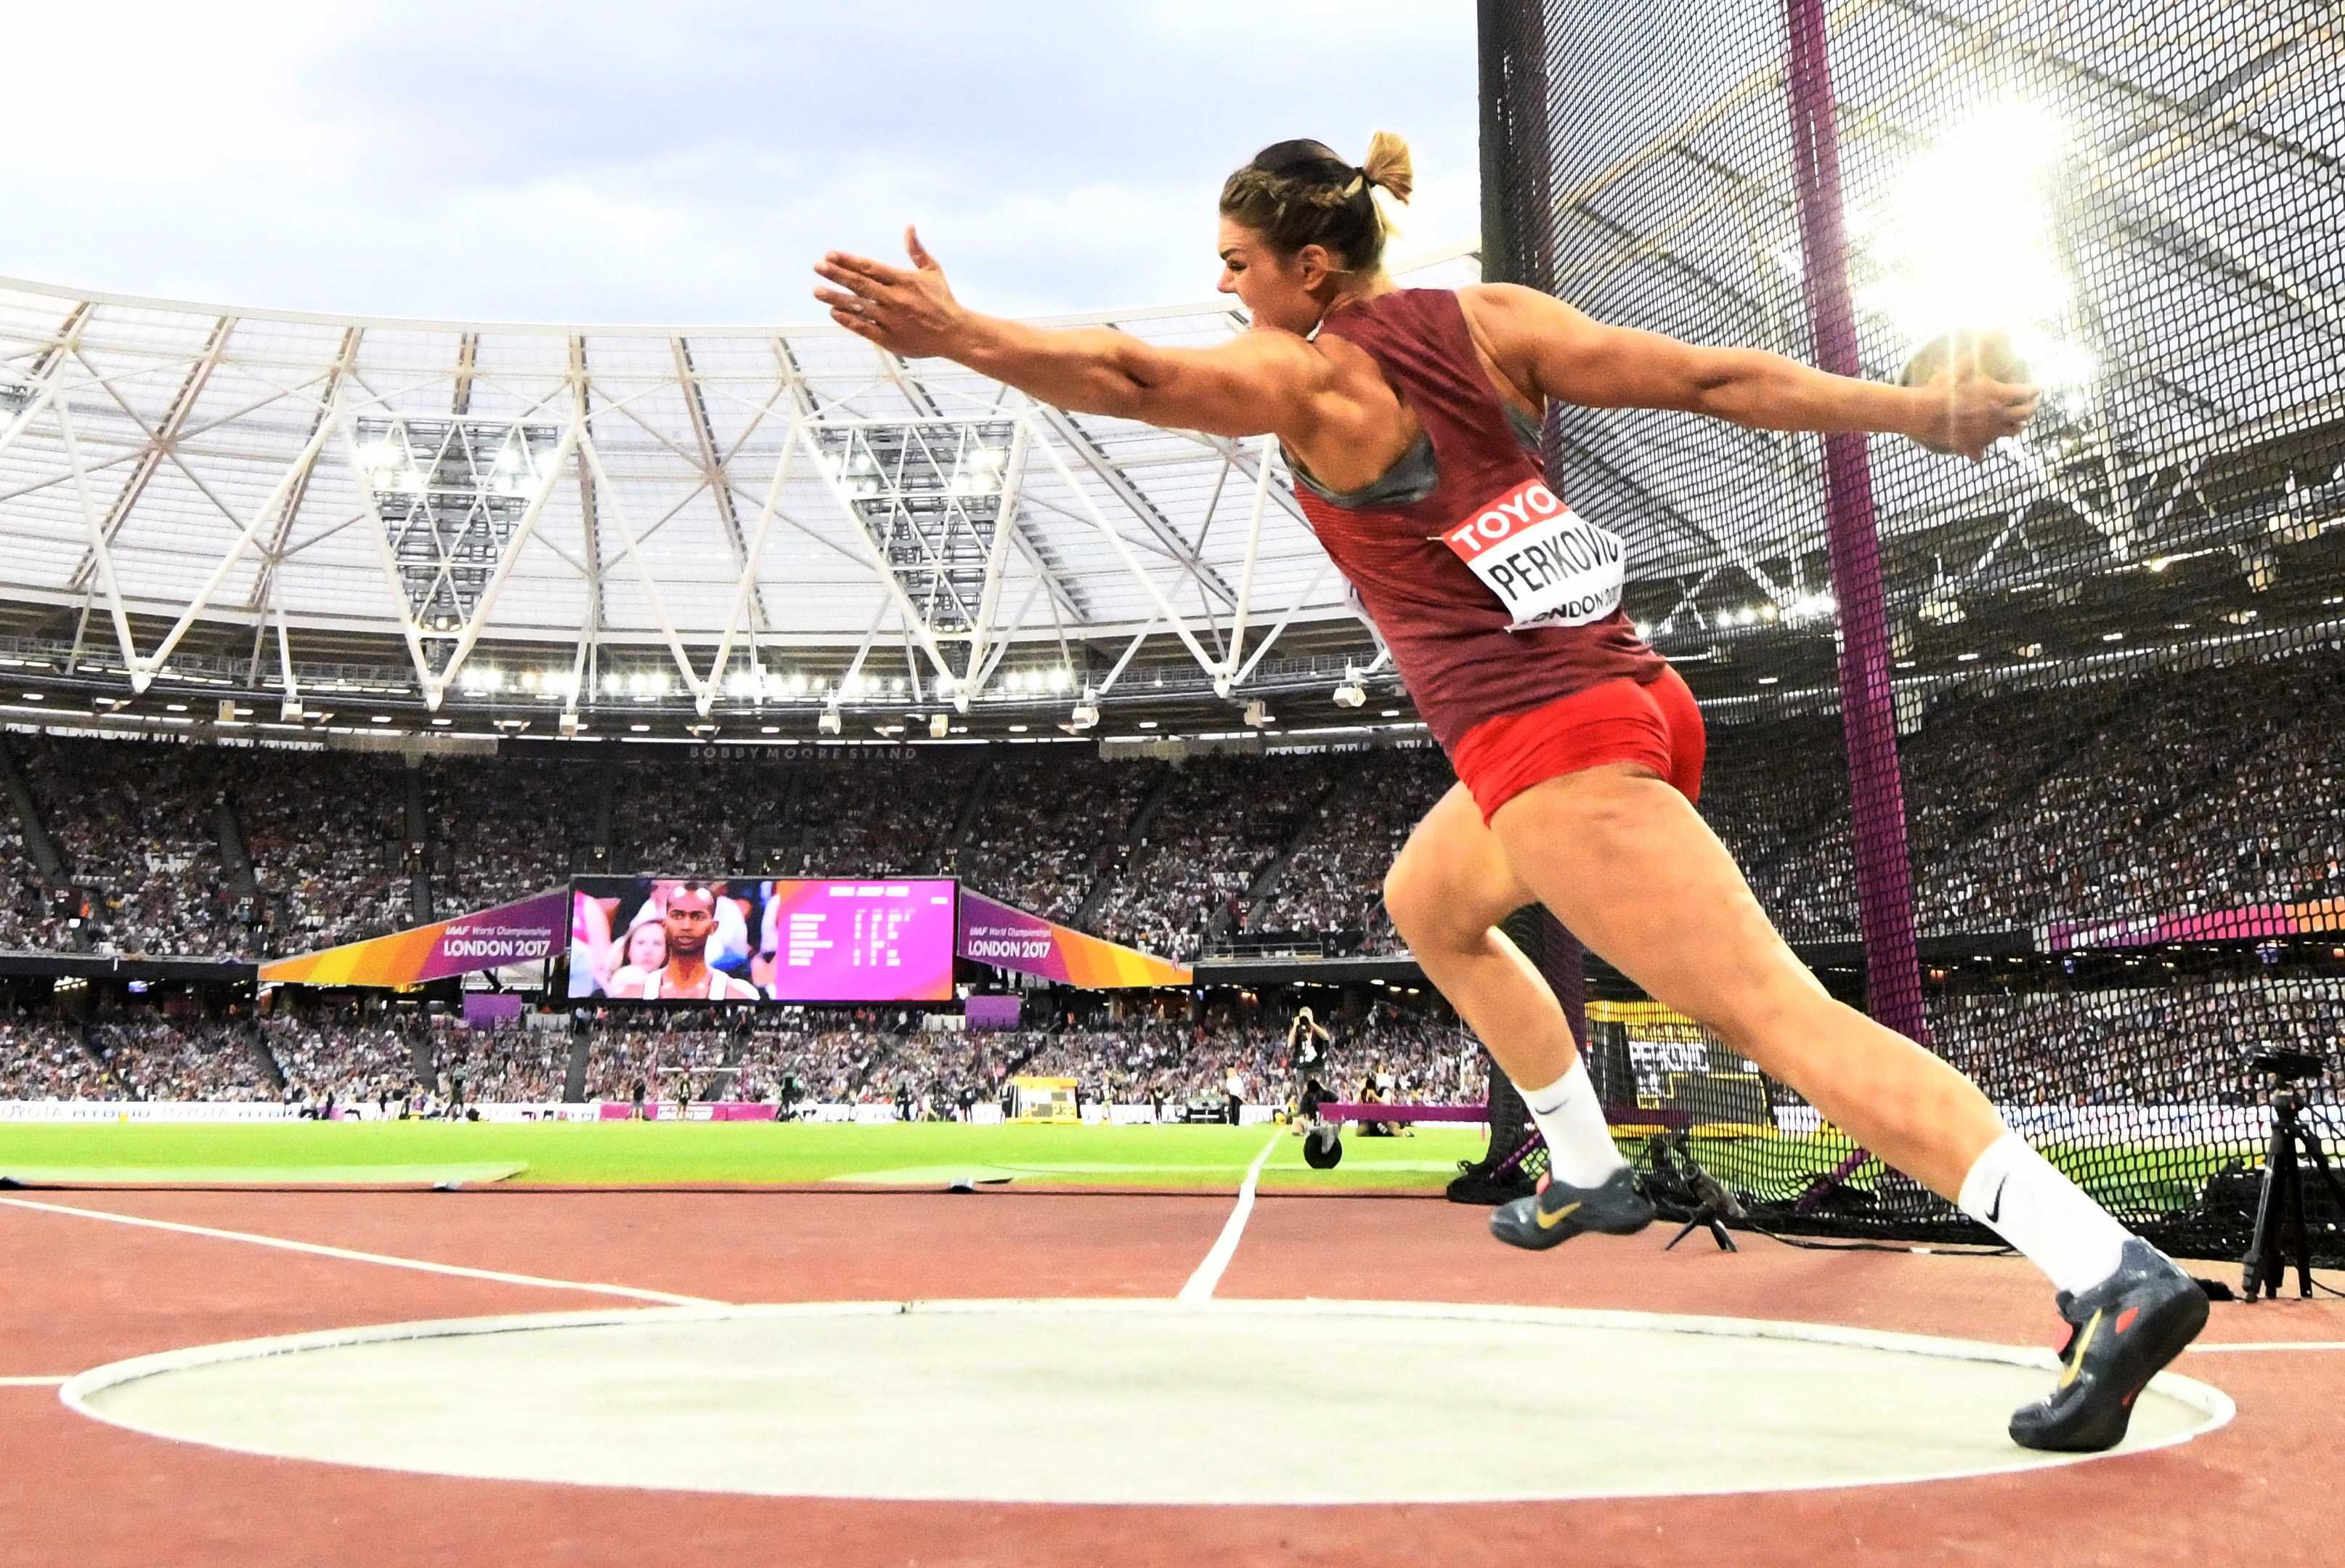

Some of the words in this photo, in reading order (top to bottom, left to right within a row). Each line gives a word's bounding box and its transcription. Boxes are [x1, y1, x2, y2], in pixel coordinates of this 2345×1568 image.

[1452, 485, 1557, 552] TOYO
[689, 747, 759, 758] BOBBY
[848, 747, 917, 760] STAND
[473, 926, 495, 935] World
[497, 926, 552, 937] Championships
[989, 927, 1007, 936] World
[1007, 927, 1052, 938] Championships
[444, 940, 513, 957] LONDON
[515, 940, 551, 957] 2017
[968, 940, 1020, 957] LONDON
[1022, 941, 1051, 958] 2017
